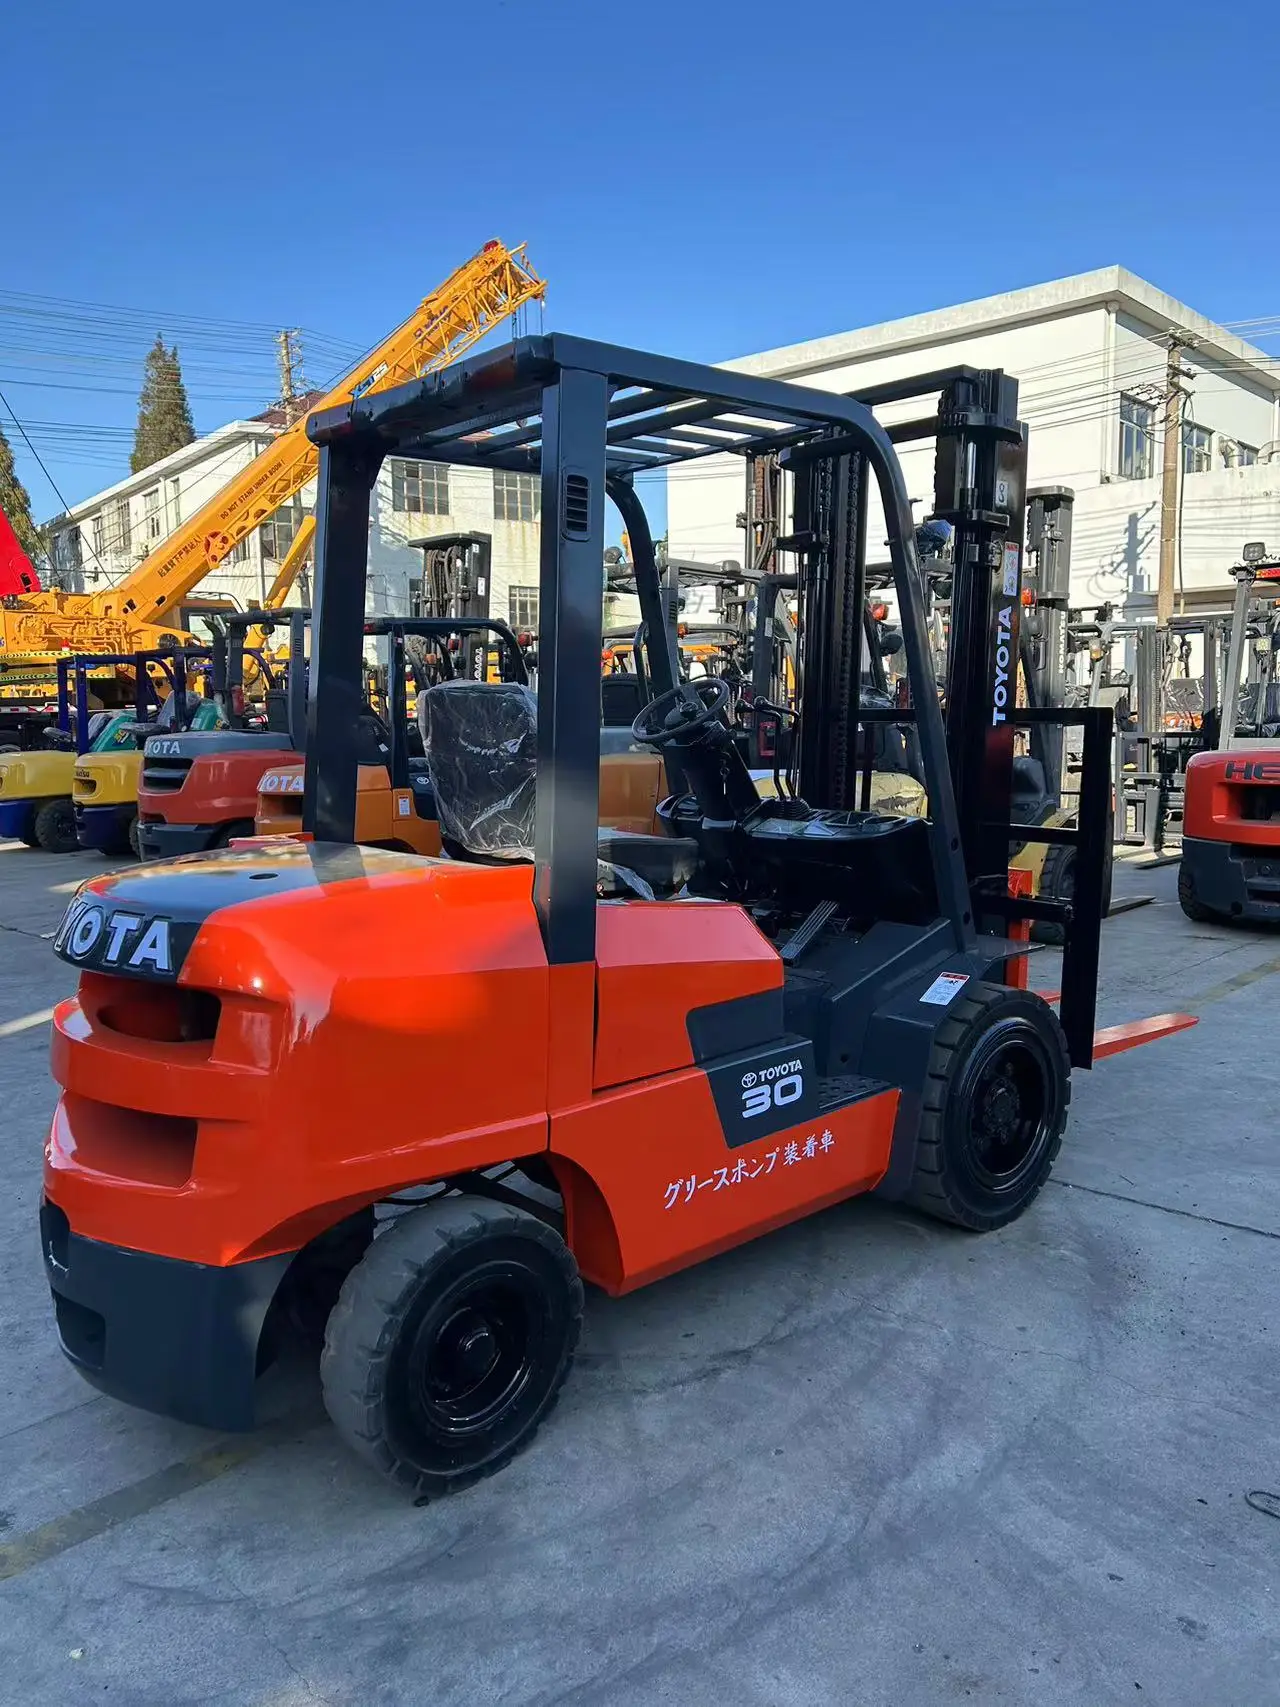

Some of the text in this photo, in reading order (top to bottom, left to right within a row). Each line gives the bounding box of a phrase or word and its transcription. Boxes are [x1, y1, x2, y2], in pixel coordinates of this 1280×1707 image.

[220, 511, 229, 520] DO
[227, 502, 239, 513] NOT
[238, 487, 255, 504] STAND
[253, 473, 270, 490] UNDER
[474, 647, 483, 681] TOYO
[993, 606, 1012, 726] TOYOTA
[758, 1059, 803, 1082] TOYOTA
[741, 1074, 803, 1119] 30
